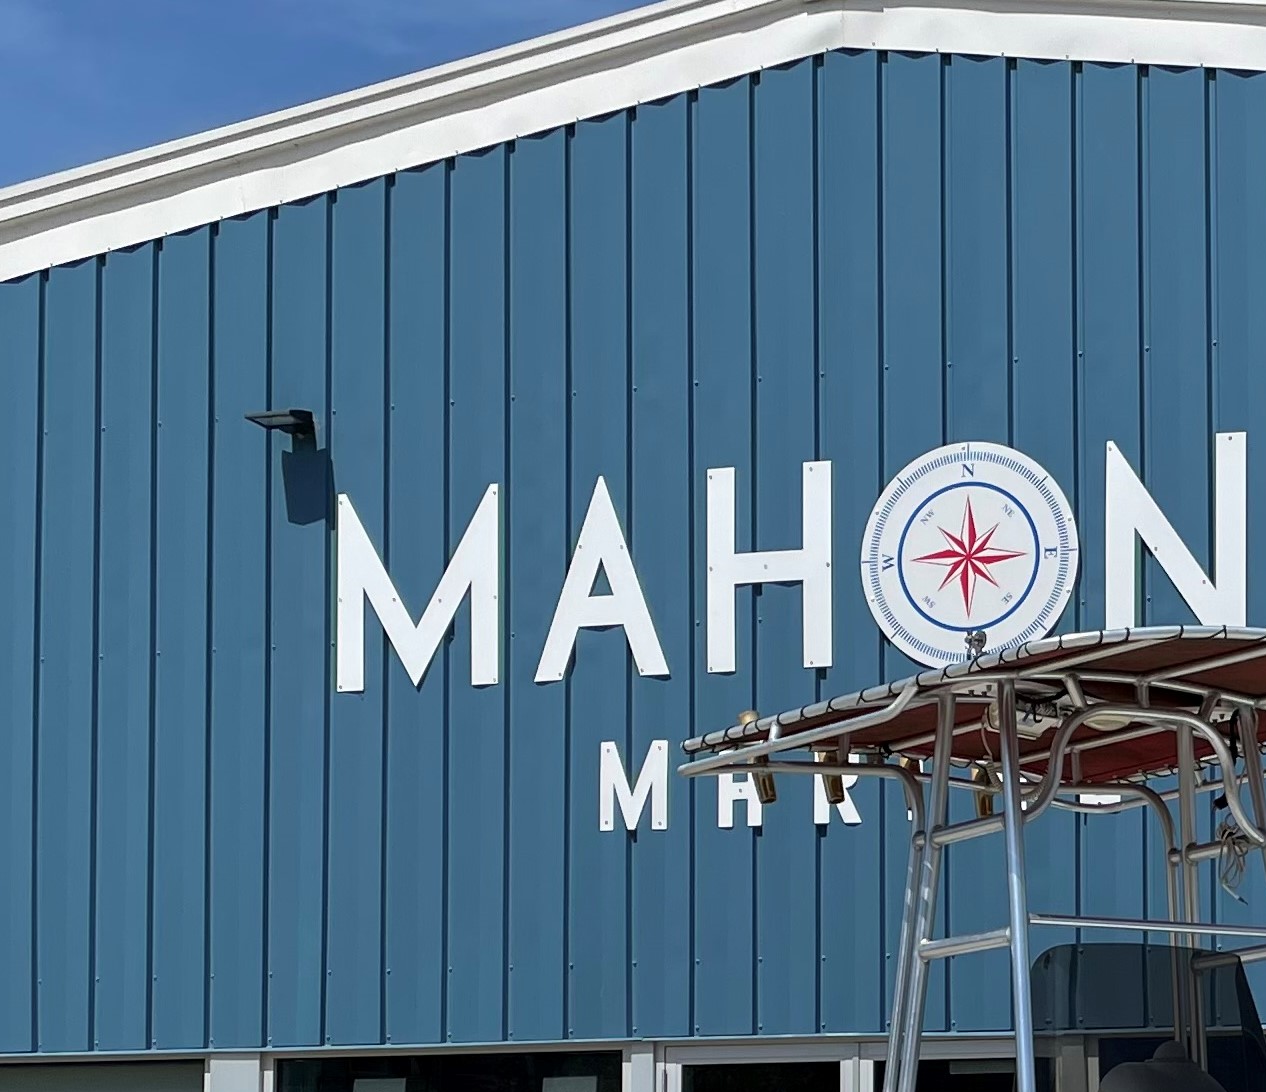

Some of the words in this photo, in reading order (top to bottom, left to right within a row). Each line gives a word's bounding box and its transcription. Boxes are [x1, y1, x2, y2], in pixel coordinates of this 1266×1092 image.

[961, 463, 975, 478] N
[1001, 503, 1015, 518] NE
[1044, 546, 1058, 560] E
[881, 553, 895, 572] W
[599, 740, 1121, 831] MAR
